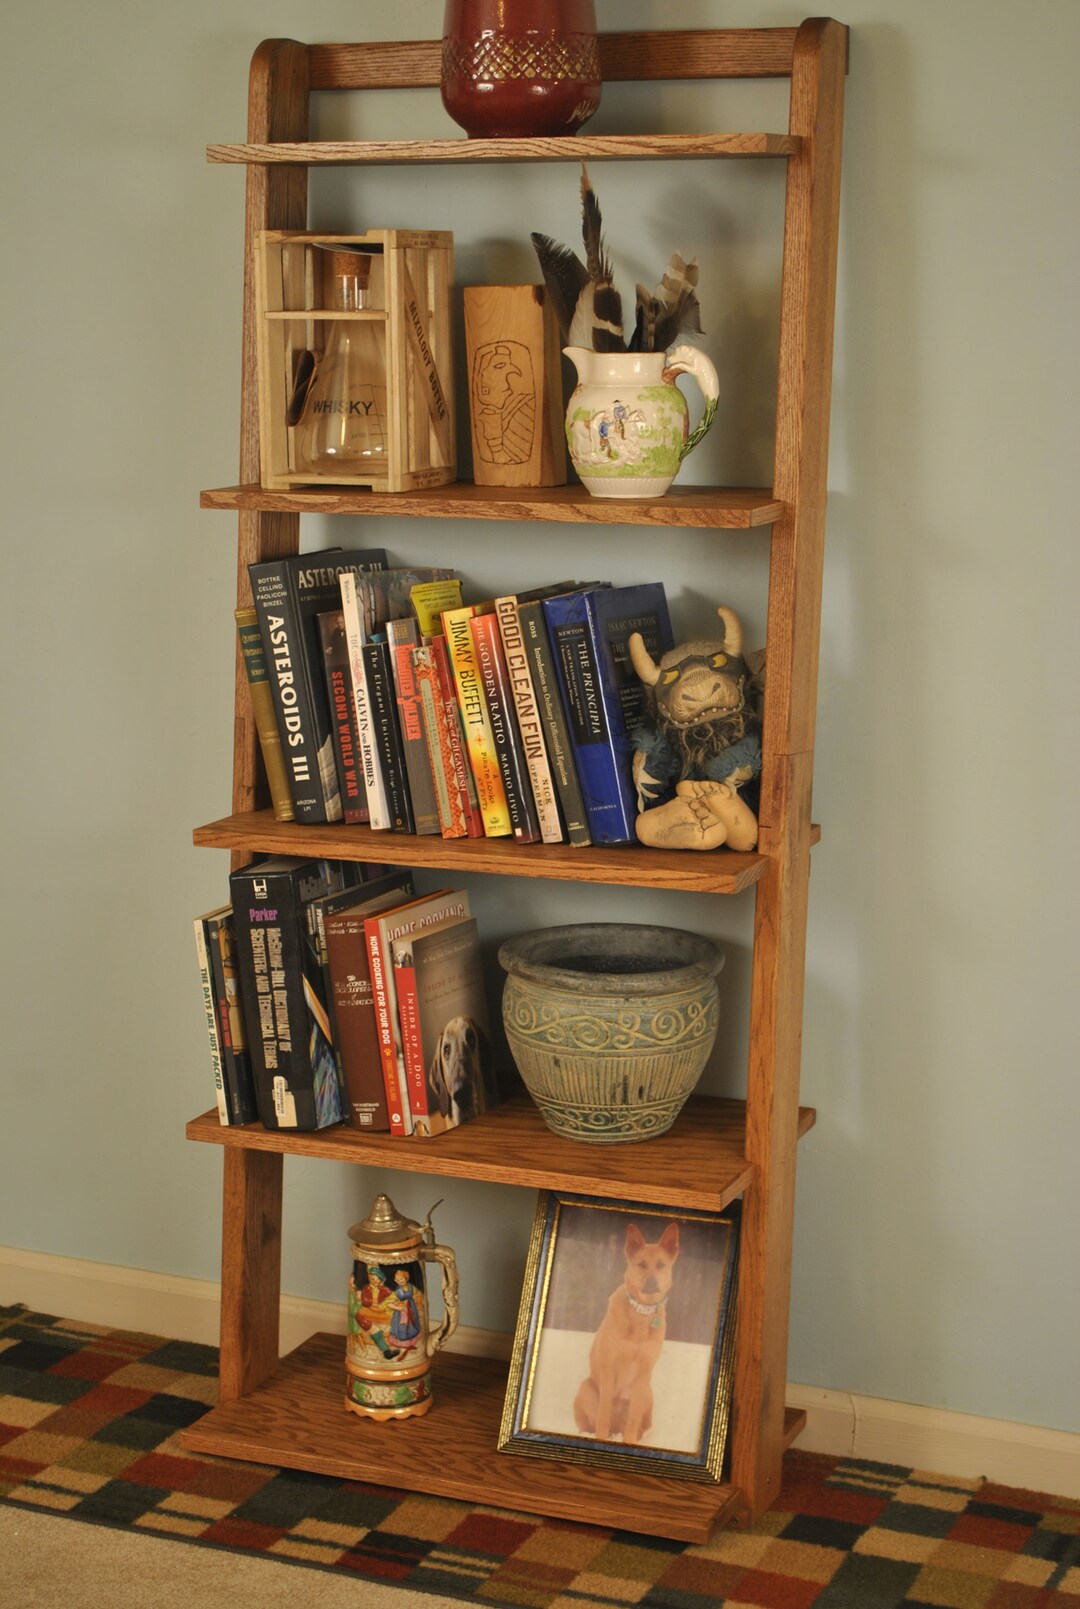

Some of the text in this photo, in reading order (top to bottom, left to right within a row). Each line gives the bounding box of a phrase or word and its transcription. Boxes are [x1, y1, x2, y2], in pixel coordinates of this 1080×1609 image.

[408, 300, 446, 420] MIXOLOGY BOTTLE
[313, 400, 373, 416] WHISKY
[256, 591, 287, 600] PAOLICCHI
[258, 576, 280, 585] BOTTKE
[258, 584, 282, 592] CELLINO
[528, 620, 536, 638] ROSS
[558, 628, 584, 637] NEWTON
[450, 620, 485, 726] JIMMY BUFFETT
[498, 601, 543, 760] GOOD CLEAN FUN
[533, 646, 548, 685] Introduction
[267, 614, 310, 782] ASTEROIDS III
[332, 671, 348, 720] SECOND
[541, 692, 555, 721] Ordinary
[578, 640, 601, 734] THE PRINCIPIA
[356, 688, 368, 731] CALVIN
[363, 744, 375, 788] HOBBES
[374, 674, 384, 713] Elegant
[381, 718, 392, 764] Universe
[480, 649, 496, 698] GOLDEN
[490, 702, 505, 744] RATIO
[500, 753, 513, 789] MARIO
[508, 792, 520, 822] LIVIO
[549, 721, 562, 755] Differential
[338, 724, 354, 766] WORLD
[452, 738, 466, 792] GILGAMESH
[345, 770, 358, 797] WAR
[555, 755, 568, 786] Equations
[530, 764, 546, 822] OFFERMAN
[542, 779, 552, 805] NICK
[249, 908, 278, 922] Parker
[250, 928, 278, 1069] SCIENTIFIC AND TECHNICAL TERMS
[266, 927, 292, 1052] McGRAW-HILL DICTIONARY OF
[369, 935, 391, 1045] HOME COOKING FOR YOUR DOG
[200, 968, 222, 1090] THE DAYS ARE JUST PACKED
[407, 992, 416, 1030] INSIDE
[411, 1035, 418, 1047] OF
